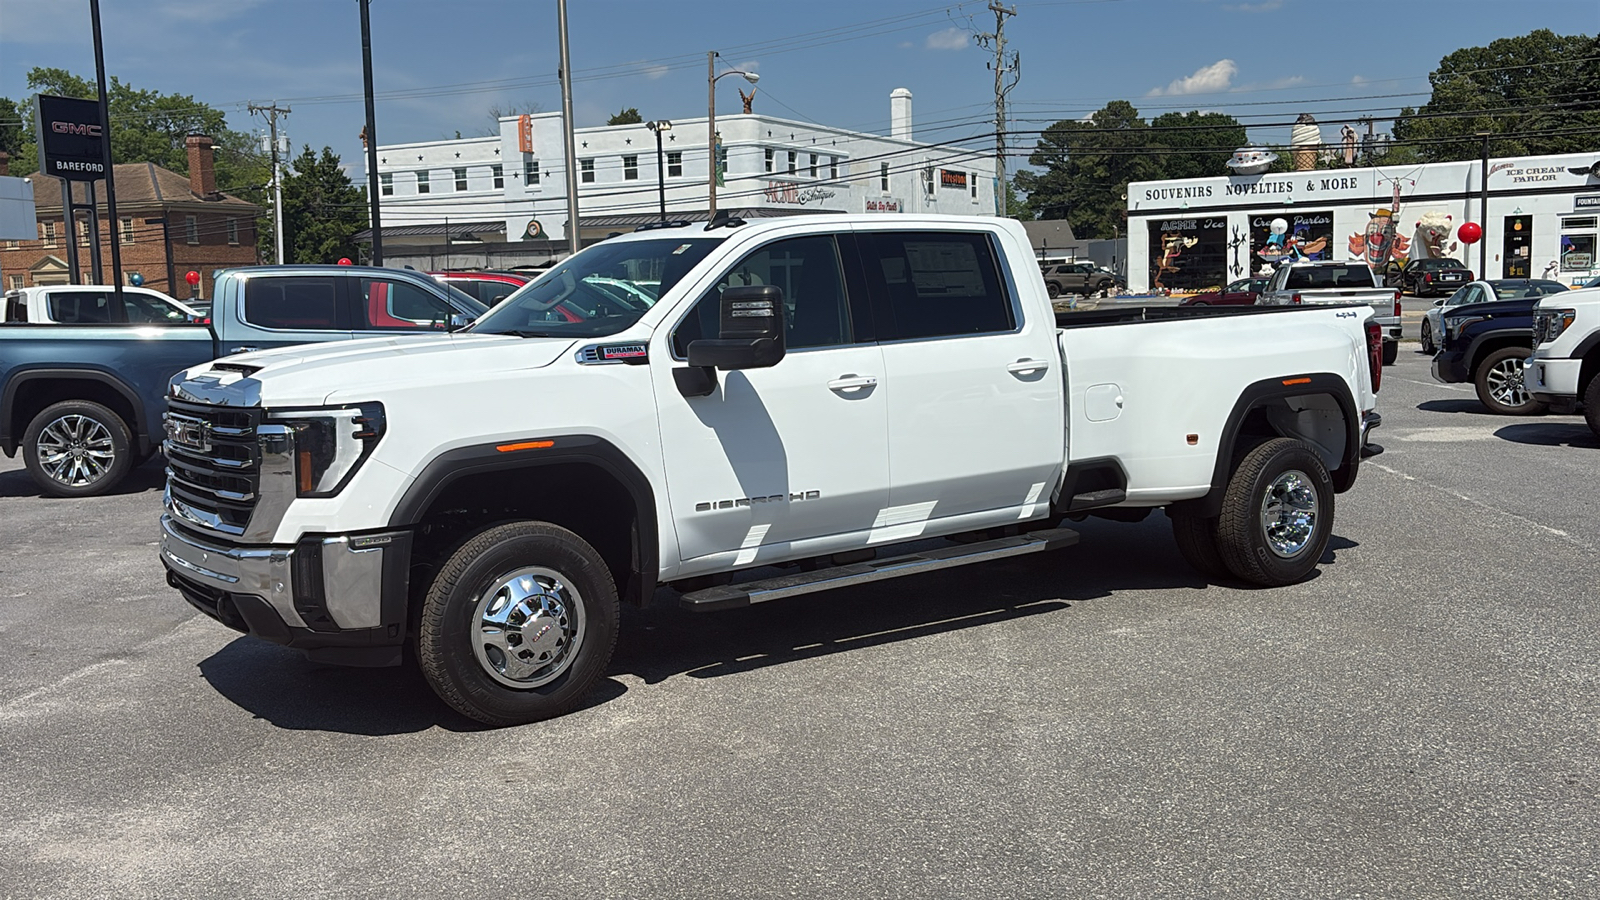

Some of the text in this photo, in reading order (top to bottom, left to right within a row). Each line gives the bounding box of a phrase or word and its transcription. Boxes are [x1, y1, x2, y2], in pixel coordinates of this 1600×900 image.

[51, 121, 102, 136] GMC
[56, 161, 104, 172] BAREFORD
[1526, 166, 1565, 175] CREAM
[941, 170, 967, 184] Firestone
[1513, 174, 1557, 183] PARLOR
[1145, 177, 1357, 201] SOUVENIRS NOVELTIES & MORE
[1160, 220, 1197, 231] ACME
[1203, 218, 1226, 229] Ice
[1293, 215, 1332, 226] Parlor
[606, 346, 644, 354] DURAMAX
[789, 490, 820, 502] HD
